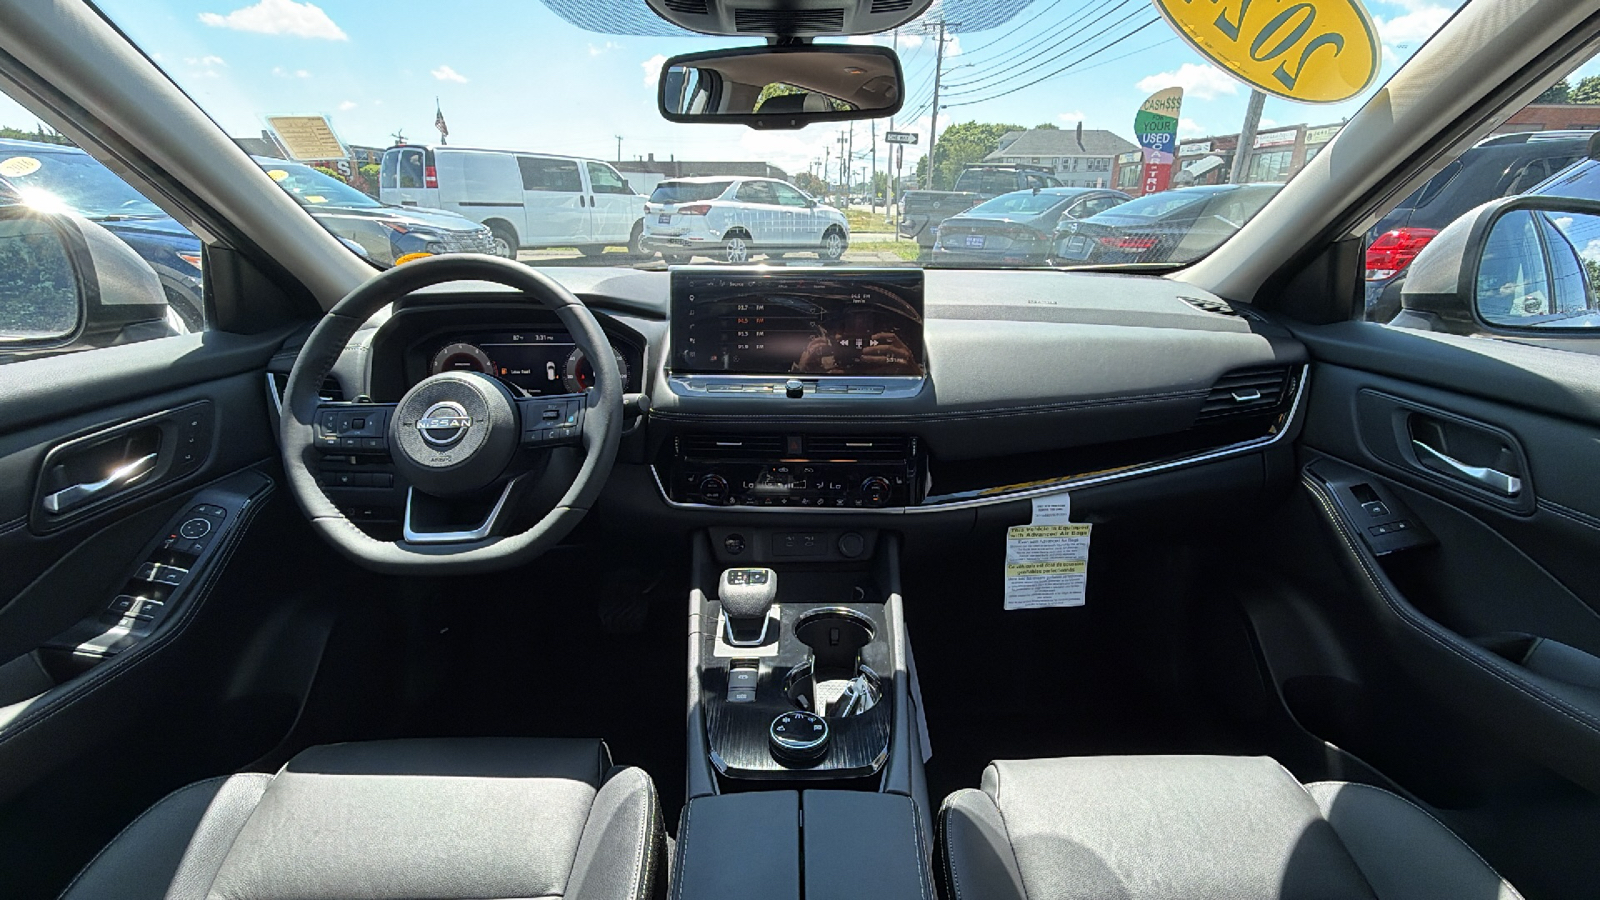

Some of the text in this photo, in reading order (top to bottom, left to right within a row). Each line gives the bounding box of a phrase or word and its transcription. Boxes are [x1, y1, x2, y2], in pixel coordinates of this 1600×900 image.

[1144, 96, 1182, 112] CASH$$$
[1143, 121, 1171, 131] YOUR
[1142, 133, 1171, 143] USED
[1145, 143, 1163, 195] CAR-TRU
[418, 419, 471, 428] NISSAN
